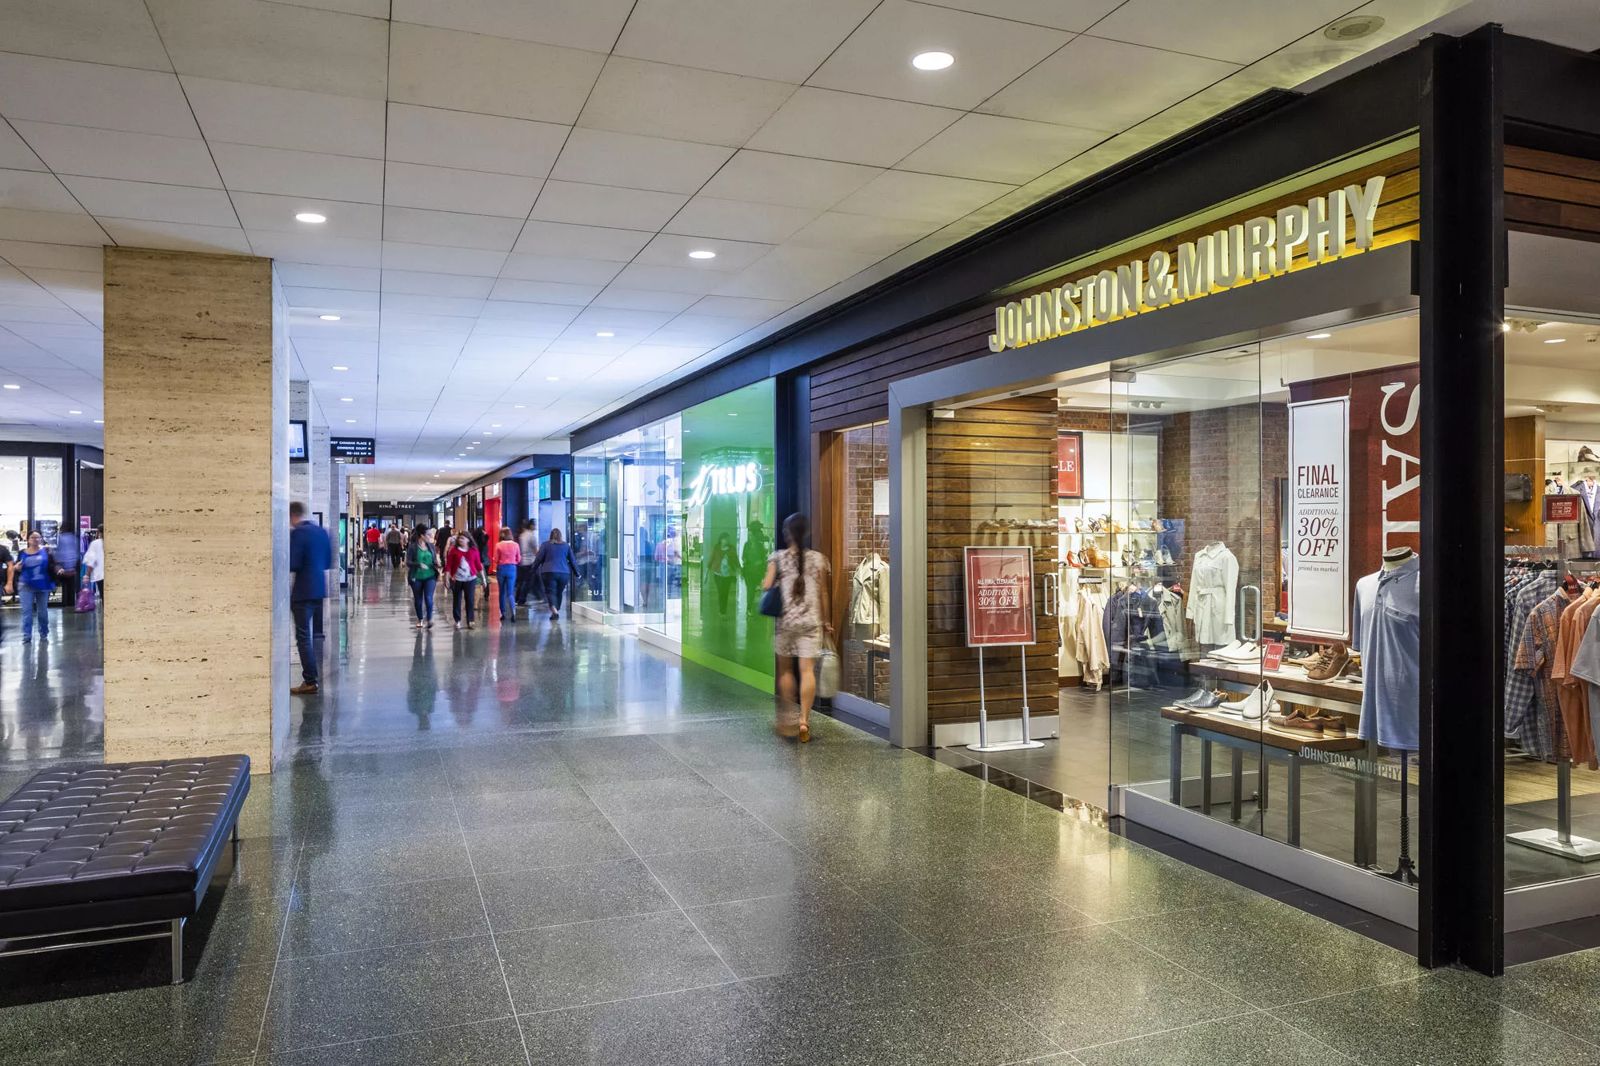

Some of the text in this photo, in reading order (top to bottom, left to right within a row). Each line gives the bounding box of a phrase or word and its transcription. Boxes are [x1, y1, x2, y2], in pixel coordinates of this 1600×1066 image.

[988, 260, 1142, 352] JOHNSTON
[1177, 176, 1385, 298] MURPHY
[1058, 461, 1075, 471] LE
[1298, 464, 1339, 486] FINAL
[1381, 382, 1420, 556] SAL
[711, 462, 759, 495] TELUS
[1298, 487, 1339, 498] CLEARANCE
[1298, 517, 1339, 537] 30%
[1298, 538, 1339, 557] OFF
[978, 595, 1018, 606] 30% OFF
[1299, 746, 1347, 768] JOHNSTON
